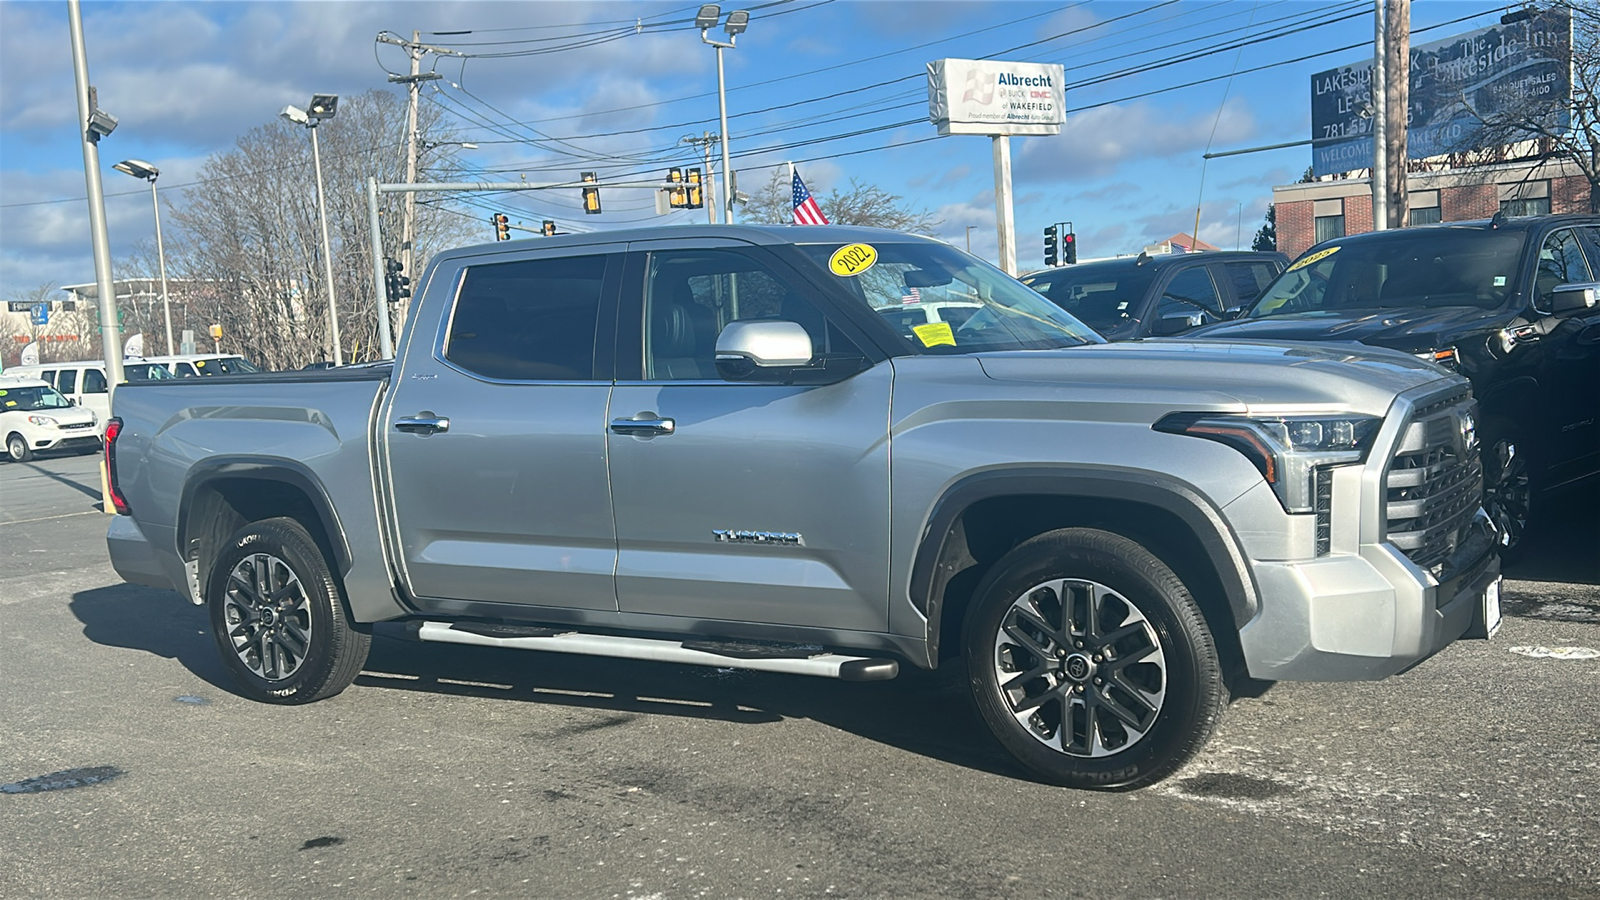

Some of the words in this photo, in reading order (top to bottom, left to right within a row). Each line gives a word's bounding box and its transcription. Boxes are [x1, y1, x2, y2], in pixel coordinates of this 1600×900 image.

[1460, 38, 1486, 57] The
[998, 73, 1052, 87] Albrecht
[1531, 73, 1557, 85] SALES
[1008, 90, 1025, 98] BUICK
[1010, 102, 1053, 111] WAKEFIELD
[1320, 141, 1371, 163] WELCOME
[837, 246, 871, 272] 2022
[1295, 250, 1330, 269] 2025
[712, 529, 806, 547] TUNDRA
